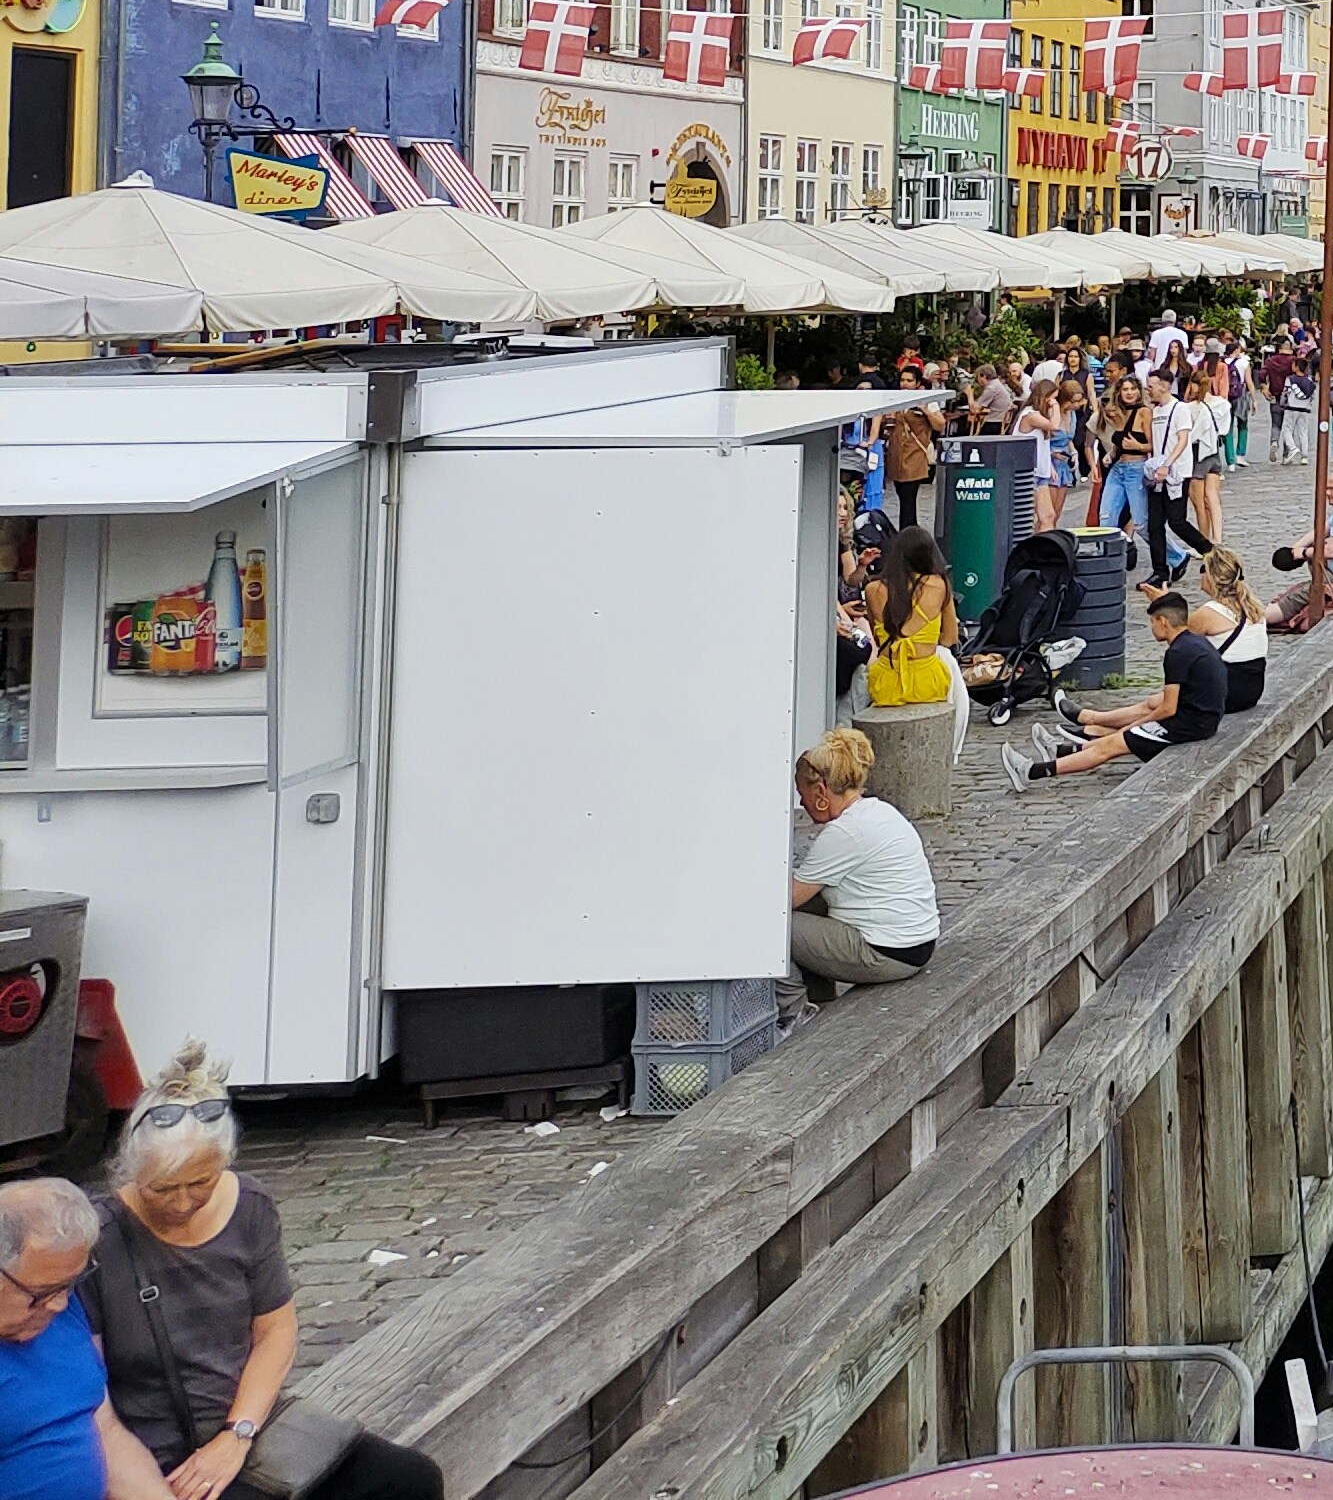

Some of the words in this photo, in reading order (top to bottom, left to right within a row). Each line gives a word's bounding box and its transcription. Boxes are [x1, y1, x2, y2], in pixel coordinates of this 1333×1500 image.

[921, 103, 979, 142] HEERING
[1017, 127, 1089, 172] NYHAVN
[1130, 147, 1163, 179] 17
[236, 160, 319, 192] Marley's
[244, 191, 303, 205] diner
[956, 478, 994, 489] Affald
[956, 491, 991, 501] Waste
